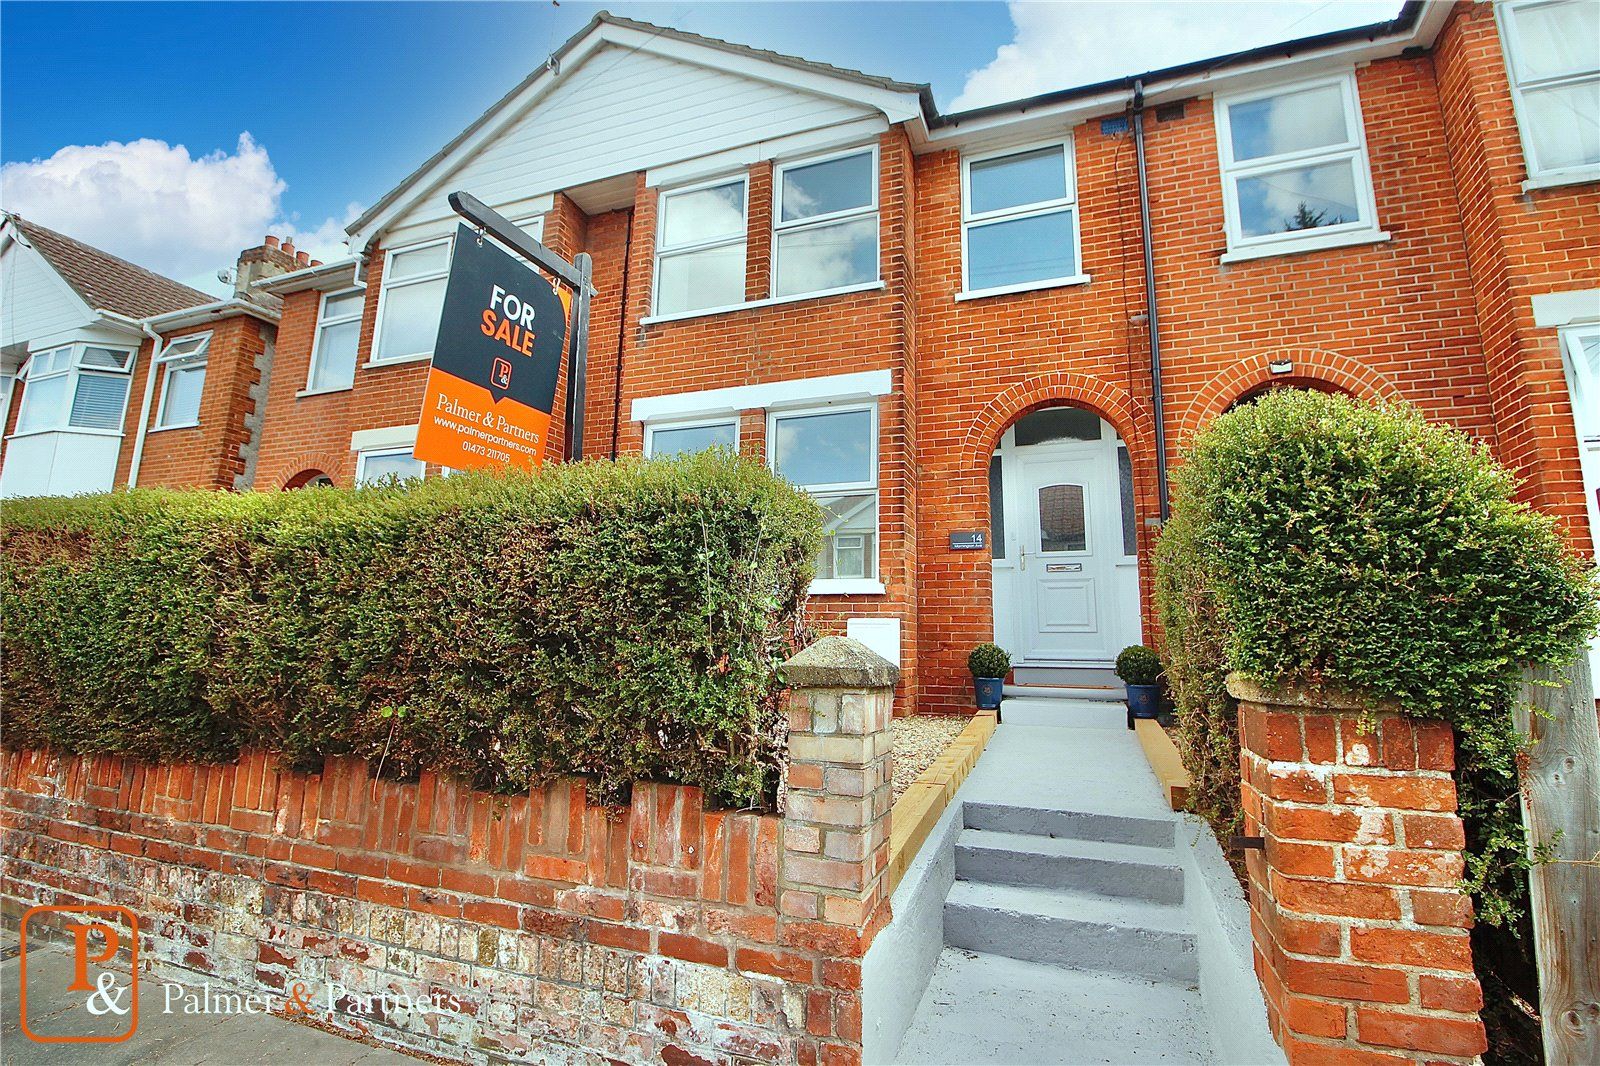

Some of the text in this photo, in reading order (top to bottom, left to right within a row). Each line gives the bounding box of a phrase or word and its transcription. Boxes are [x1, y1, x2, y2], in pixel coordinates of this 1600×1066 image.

[490, 284, 535, 331] FOR
[481, 309, 536, 357] SALE
[499, 363, 508, 378] P
[500, 375, 508, 385] &
[436, 393, 539, 444] Palmer & Partners
[434, 416, 537, 456] www.palmerpartners.com
[462, 440, 511, 464] 01473 211705
[971, 534, 982, 542] 14
